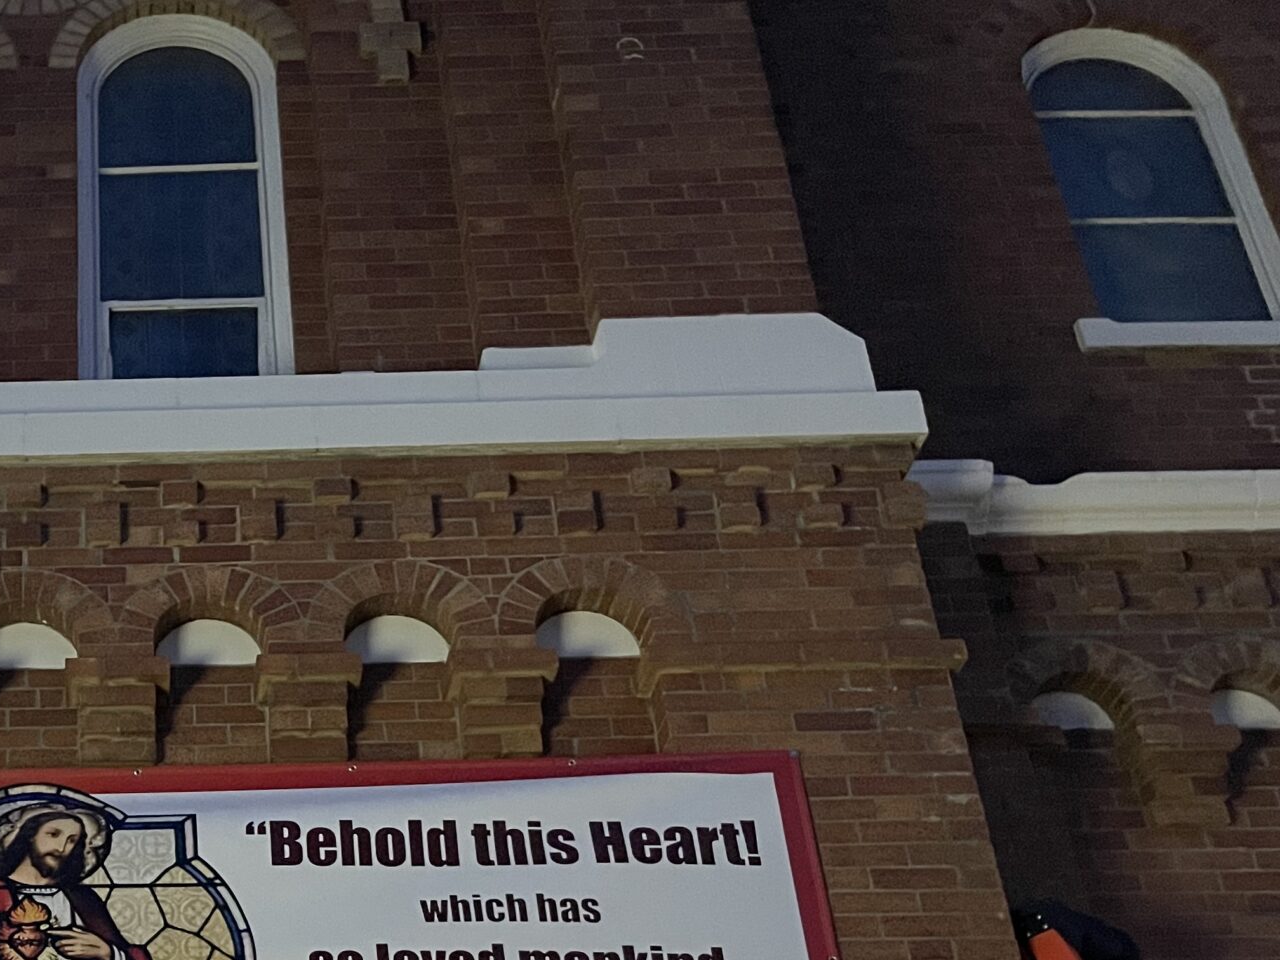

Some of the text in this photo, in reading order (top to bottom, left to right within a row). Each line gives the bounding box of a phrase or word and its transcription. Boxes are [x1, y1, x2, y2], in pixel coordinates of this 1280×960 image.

[246, 819, 762, 868] “Behold this Heart!
[420, 892, 601, 924] which has
